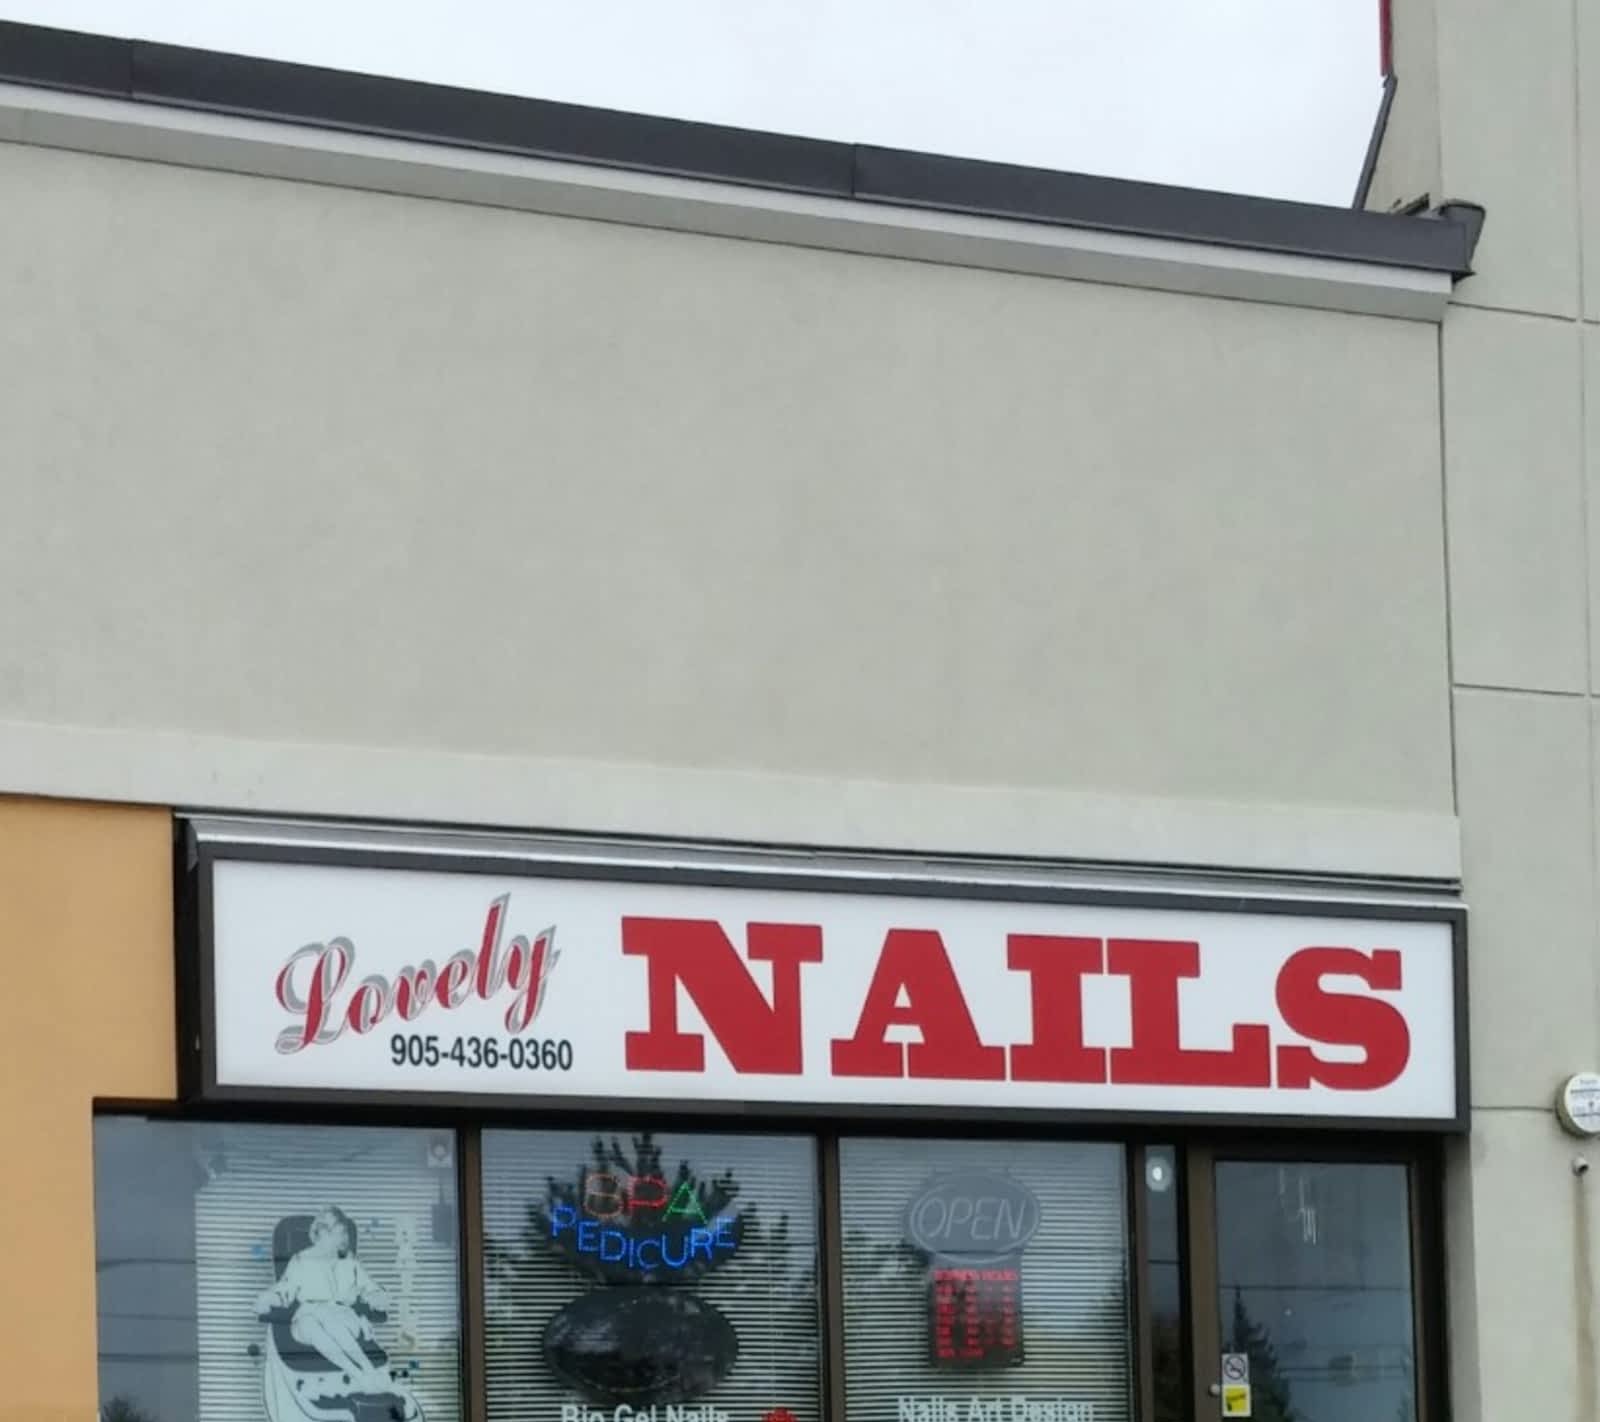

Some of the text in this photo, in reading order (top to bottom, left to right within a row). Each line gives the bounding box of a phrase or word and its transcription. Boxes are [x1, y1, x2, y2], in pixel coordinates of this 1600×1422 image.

[275, 891, 1411, 1091] Lovely NAILS
[390, 1034, 573, 1071] 905-436-0360
[584, 1172, 708, 1224] SPA
[917, 1197, 1027, 1241] OPEN
[551, 1206, 736, 1270] PEDICURE
